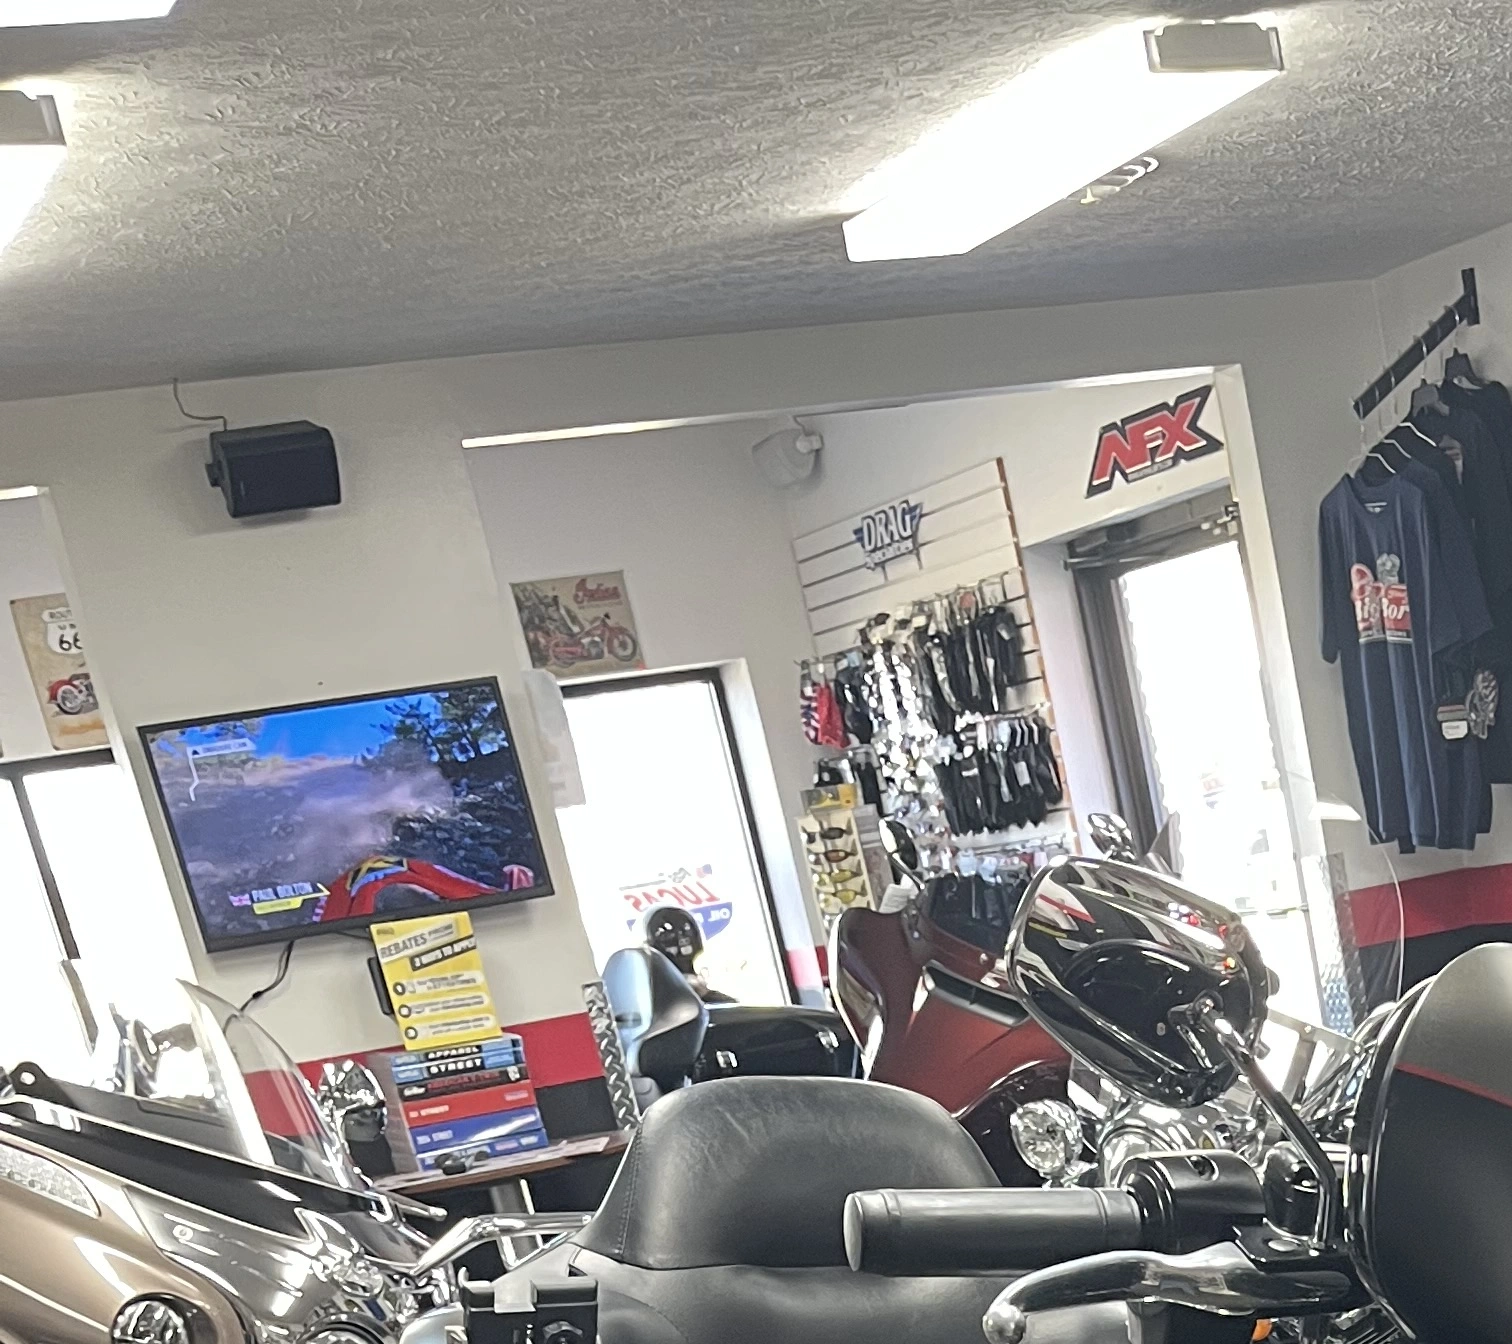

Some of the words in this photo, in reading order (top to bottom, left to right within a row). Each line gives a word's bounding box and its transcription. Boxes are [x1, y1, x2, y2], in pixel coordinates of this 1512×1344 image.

[1091, 396, 1208, 486] AFX
[861, 498, 914, 554] DRAG
[380, 932, 428, 958] REBATES
[427, 1046, 480, 1060] APPAREL
[429, 1058, 482, 1074] STREET
